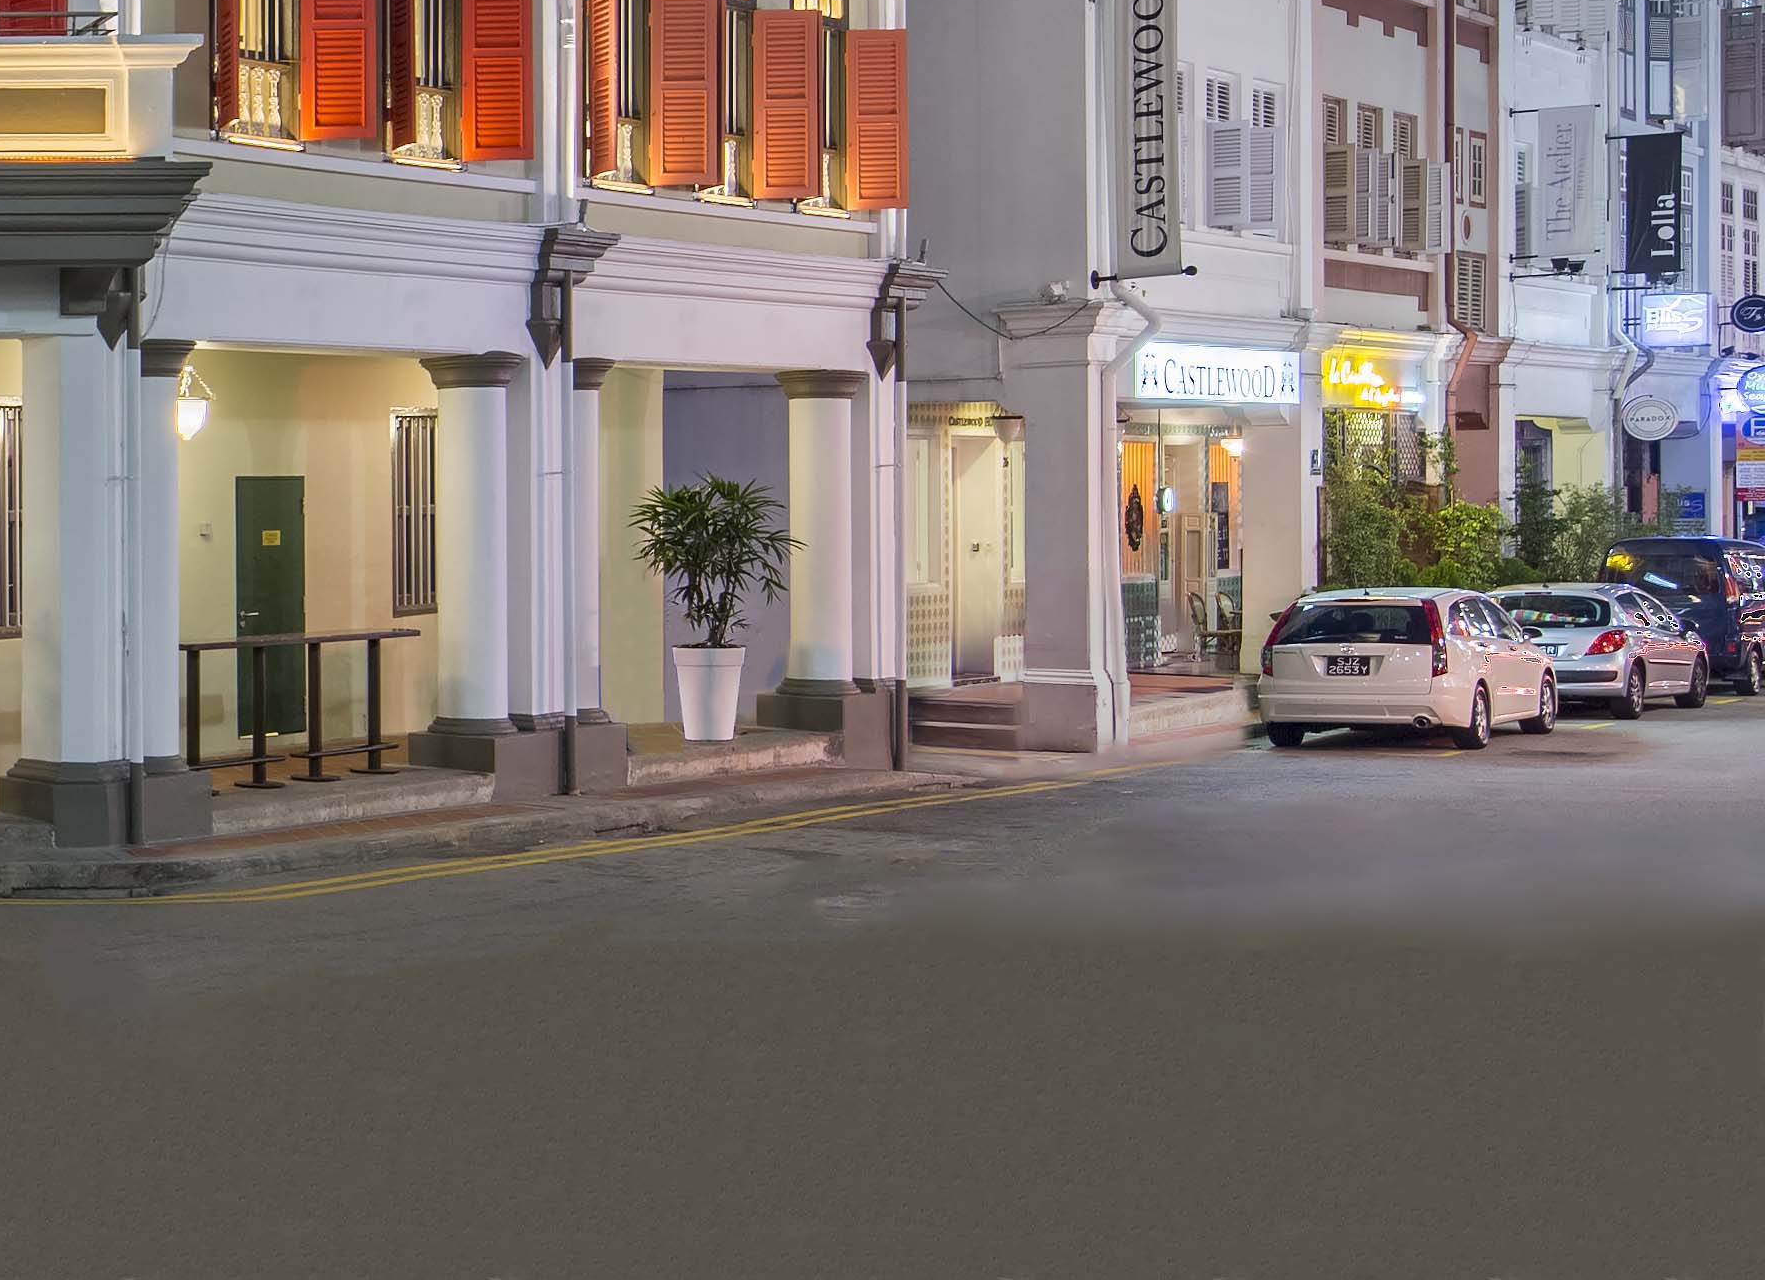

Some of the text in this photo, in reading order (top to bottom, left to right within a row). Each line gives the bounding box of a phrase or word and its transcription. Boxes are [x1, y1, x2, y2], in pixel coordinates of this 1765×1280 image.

[1546, 196, 1572, 241] The
[1650, 193, 1675, 257] Lolla
[1164, 358, 1276, 398] CASTLEWOOD
[1629, 415, 1671, 423] PARADOX
[1337, 657, 1360, 666] SJZ
